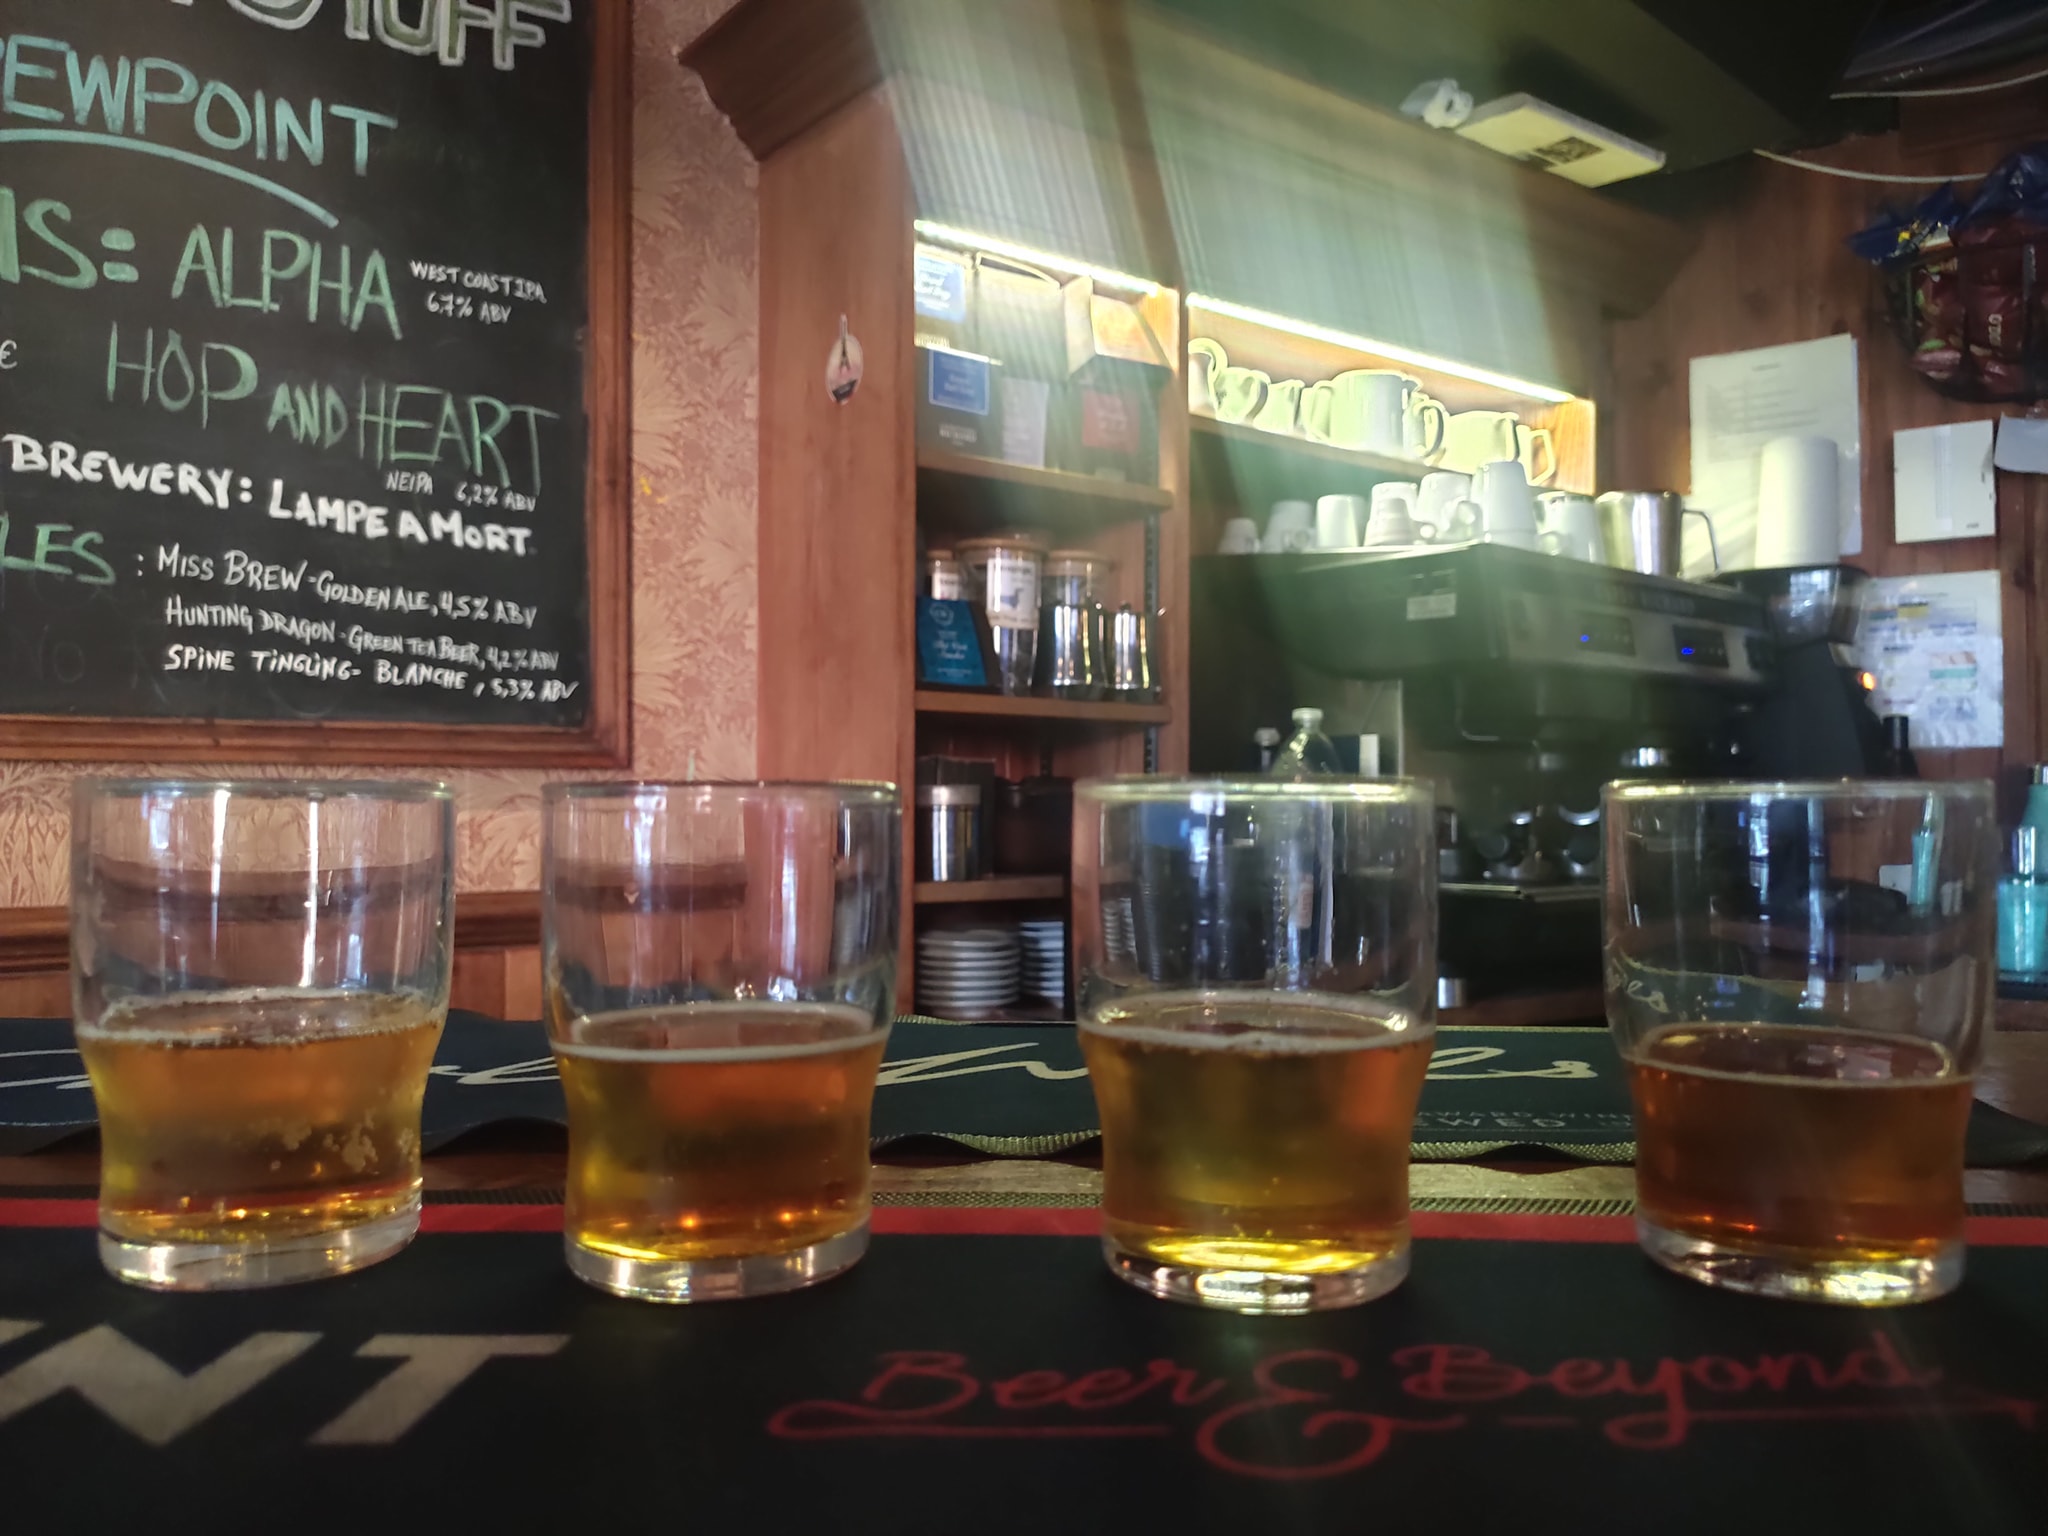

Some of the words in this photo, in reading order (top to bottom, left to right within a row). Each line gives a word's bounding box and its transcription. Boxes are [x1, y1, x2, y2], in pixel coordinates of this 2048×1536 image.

[0, 35, 398, 176] EWPOINT
[172, 222, 403, 341] ALPHA
[409, 259, 461, 284] WEST
[462, 270, 513, 297] COAST
[513, 277, 547, 304] IPA
[479, 301, 512, 324] ABV
[106, 320, 259, 430] HOP
[266, 381, 348, 449] AND
[356, 377, 561, 496] HEART
[1, 433, 252, 509] BREWERY:
[268, 478, 389, 540] LAMPE
[396, 510, 429, 543] A
[384, 469, 434, 495] NEIPA
[454, 481, 499, 507] 6,2%
[502, 489, 537, 512] ABV
[157, 542, 215, 582] MISS
[492, 598, 538, 630] ABV
[165, 593, 253, 636] HUNTING
[257, 607, 336, 646] DRAGON
[348, 624, 405, 655] GREEN
[404, 636, 437, 660] TEA
[528, 649, 561, 673] ABV
[538, 679, 581, 703] ABV
[0, 1319, 572, 1446] NT
[778, 1349, 1222, 1436] Beer
[1197, 1349, 1400, 1481] &
[1391, 1330, 1942, 1450] Beyond
